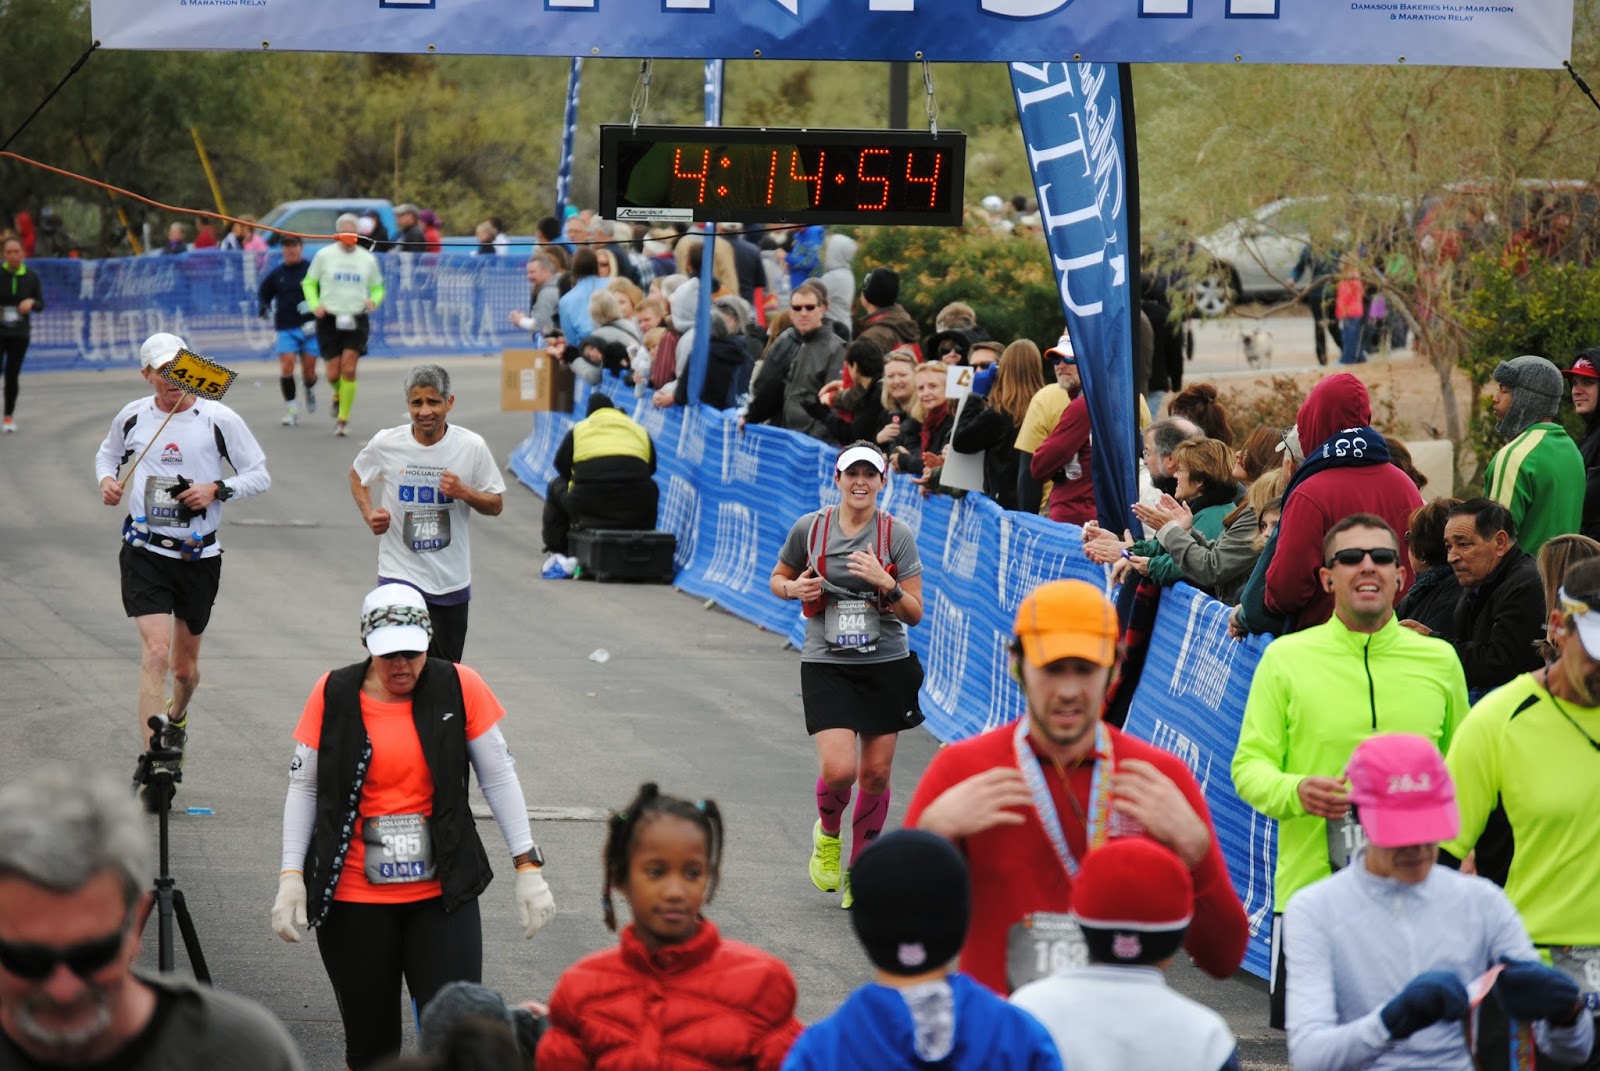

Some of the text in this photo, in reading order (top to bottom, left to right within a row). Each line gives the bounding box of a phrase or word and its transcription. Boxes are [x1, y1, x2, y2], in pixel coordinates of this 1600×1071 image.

[1350, 3, 1514, 13] DAMASOUS BAKERIES HALF-MARATHON
[1398, 13, 1446, 21] MARATHON
[188, 357, 224, 377] PACE TIME
[172, 368, 222, 394] 4:15
[405, 469, 443, 477] HOLUALO
[412, 521, 439, 538] 746
[838, 613, 866, 631] 644
[378, 818, 420, 827] HOLUALOA
[381, 832, 421, 857] 385
